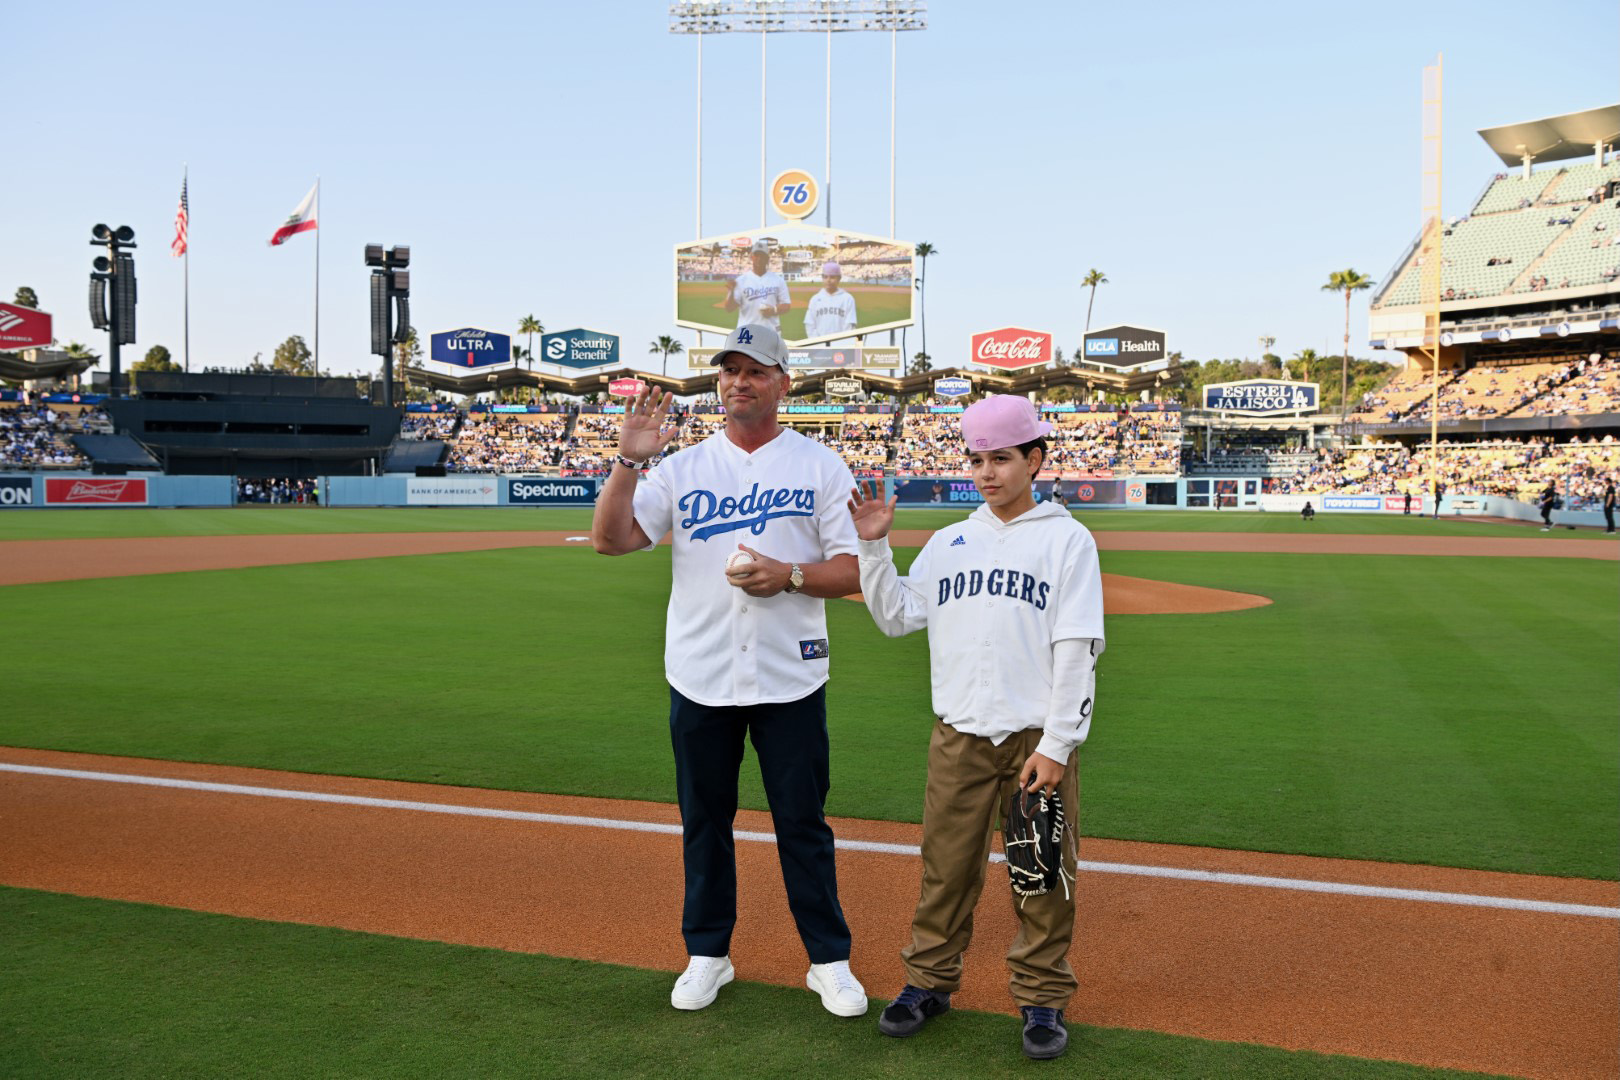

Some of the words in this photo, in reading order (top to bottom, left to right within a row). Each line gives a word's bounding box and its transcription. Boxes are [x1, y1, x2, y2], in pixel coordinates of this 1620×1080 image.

[782, 183, 808, 204] 76
[737, 327, 753, 344] LA
[447, 339, 494, 350] ULTRA
[571, 338, 613, 352] Security
[977, 336, 1045, 360] Coca-Cola
[1087, 342, 1115, 352] UCLA
[1121, 340, 1160, 353] Health
[571, 350, 608, 360] Benefit
[1213, 397, 1287, 408] JALISCO
[512, 482, 584, 500] Spectrum
[950, 483, 978, 491] TYLE
[1081, 488, 1092, 497] 76
[1130, 488, 1142, 497] 76
[678, 483, 815, 536] Dodgers
[938, 568, 1050, 611] DODGERS
